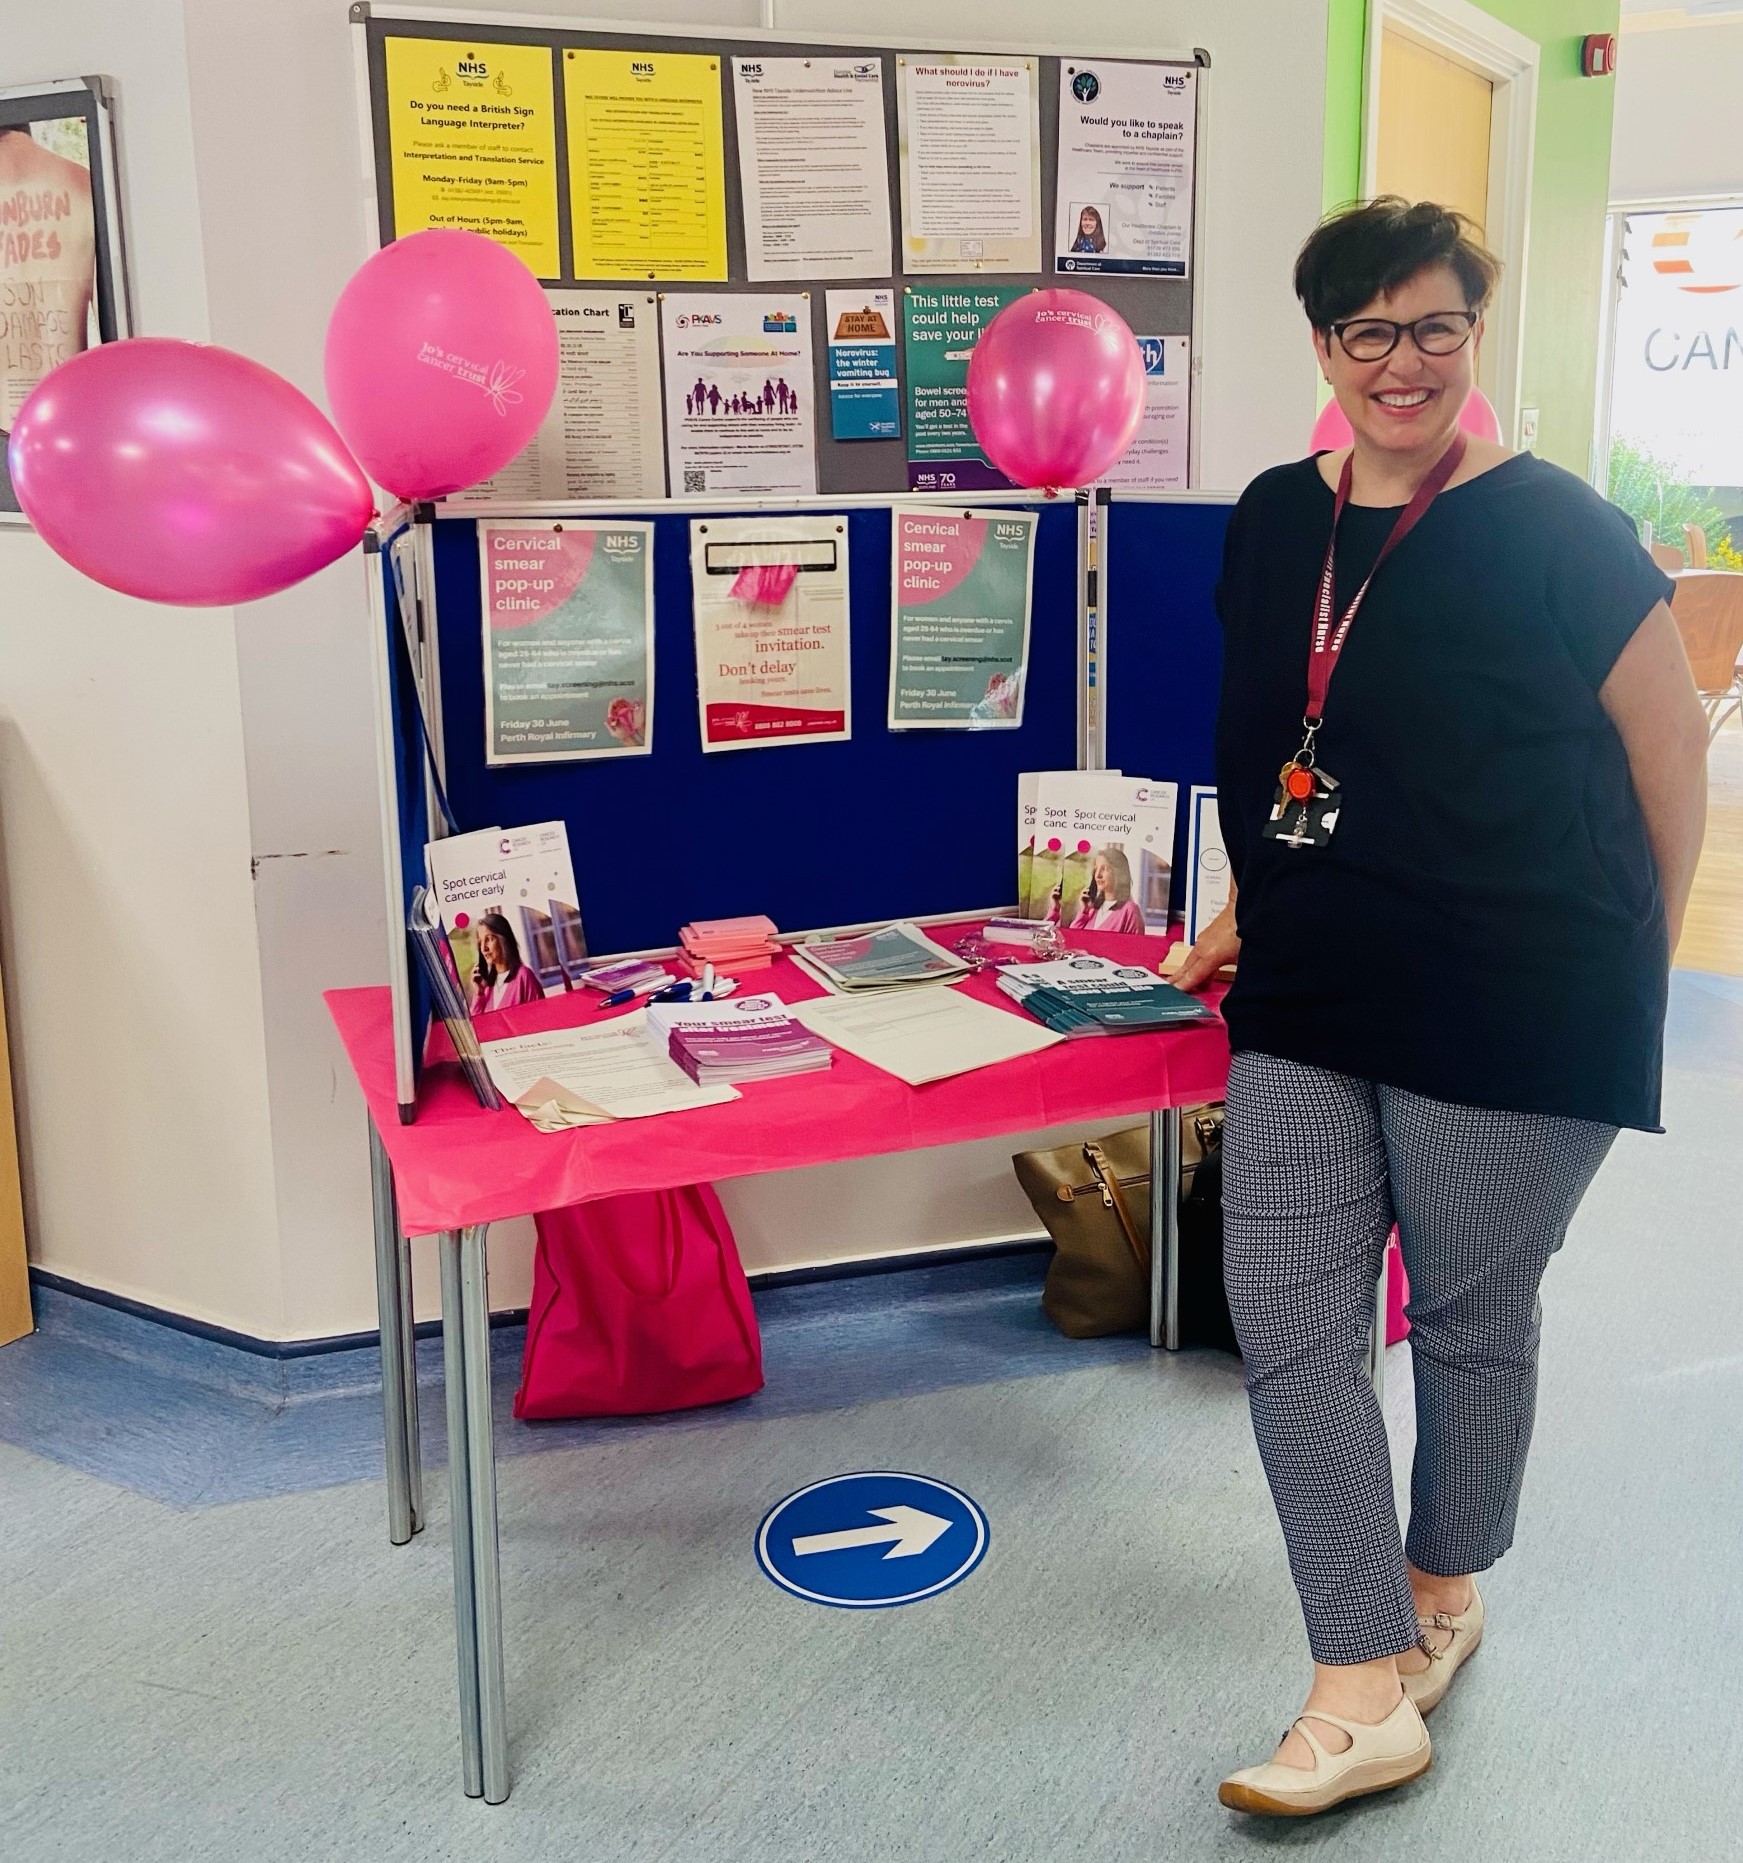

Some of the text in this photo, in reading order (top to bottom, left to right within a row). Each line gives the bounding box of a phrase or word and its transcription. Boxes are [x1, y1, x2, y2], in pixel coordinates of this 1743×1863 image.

[458, 62, 487, 74] NHS
[632, 62, 654, 72] NHS
[742, 64, 762, 72] NHS
[916, 68, 938, 76] What
[940, 68, 968, 76] should
[946, 80, 990, 88] norovirus?
[1165, 76, 1184, 86] NHS
[410, 100, 423, 109] Do
[427, 103, 444, 112] you
[447, 104, 470, 112] need
[482, 105, 511, 114] British
[514, 106, 534, 117] Sign
[421, 117, 524, 130] Language Interpreter?
[1080, 116, 1184, 130] Would you like to speak
[1122, 130, 1132, 138] to
[1141, 130, 1184, 140] chaplain?
[404, 152, 456, 161] Interpretation
[475, 155, 516, 164] Translation
[422, 174, 528, 188] Monday-Friday (9am-5pm)
[492, 228, 528, 237] holidays)
[4, 277, 45, 306] SUN
[911, 295, 999, 307] This little test
[584, 308, 610, 316] Chart
[1057, 311, 1092, 320] cervical
[692, 314, 722, 324] PKAVS
[912, 312, 979, 326] could help
[1068, 316, 1092, 326] trust
[848, 324, 876, 332] HOME
[912, 330, 942, 340] save
[946, 330, 974, 343] your
[422, 342, 489, 374] Jo's cervical
[836, 349, 878, 357] Norovirus:
[418, 354, 486, 384] cancer trust
[837, 368, 890, 378] vomiting bug
[915, 387, 941, 396] Bowel
[915, 398, 926, 407] for
[951, 398, 968, 406] and
[916, 410, 936, 420] aged
[940, 474, 956, 482] 70
[904, 522, 960, 536] Cervical
[996, 524, 1024, 536] NHS
[494, 537, 561, 550] Cervical
[606, 536, 638, 548] NHS
[904, 541, 946, 552] smear
[495, 560, 544, 570] smear
[904, 560, 952, 574] pop-up
[496, 580, 554, 592] pop-up
[904, 576, 940, 588] clinic
[496, 598, 540, 610] clinic
[778, 627, 810, 636] smear
[812, 625, 831, 634] test
[1315, 623, 1328, 652] Nurse
[755, 638, 824, 652] invitation.
[720, 660, 796, 676] Don't delay
[901, 690, 925, 698] Friday
[922, 702, 942, 710] Royal
[500, 720, 530, 730] Friday
[500, 731, 596, 742] Perth Royal Infirmary
[1044, 807, 1067, 818] Spot
[1074, 809, 1136, 822] Spot cervical
[1074, 822, 1132, 835] cancer early
[443, 870, 506, 892] Spot cervical
[445, 884, 504, 902] cancer early
[710, 1018, 756, 1026] smear
